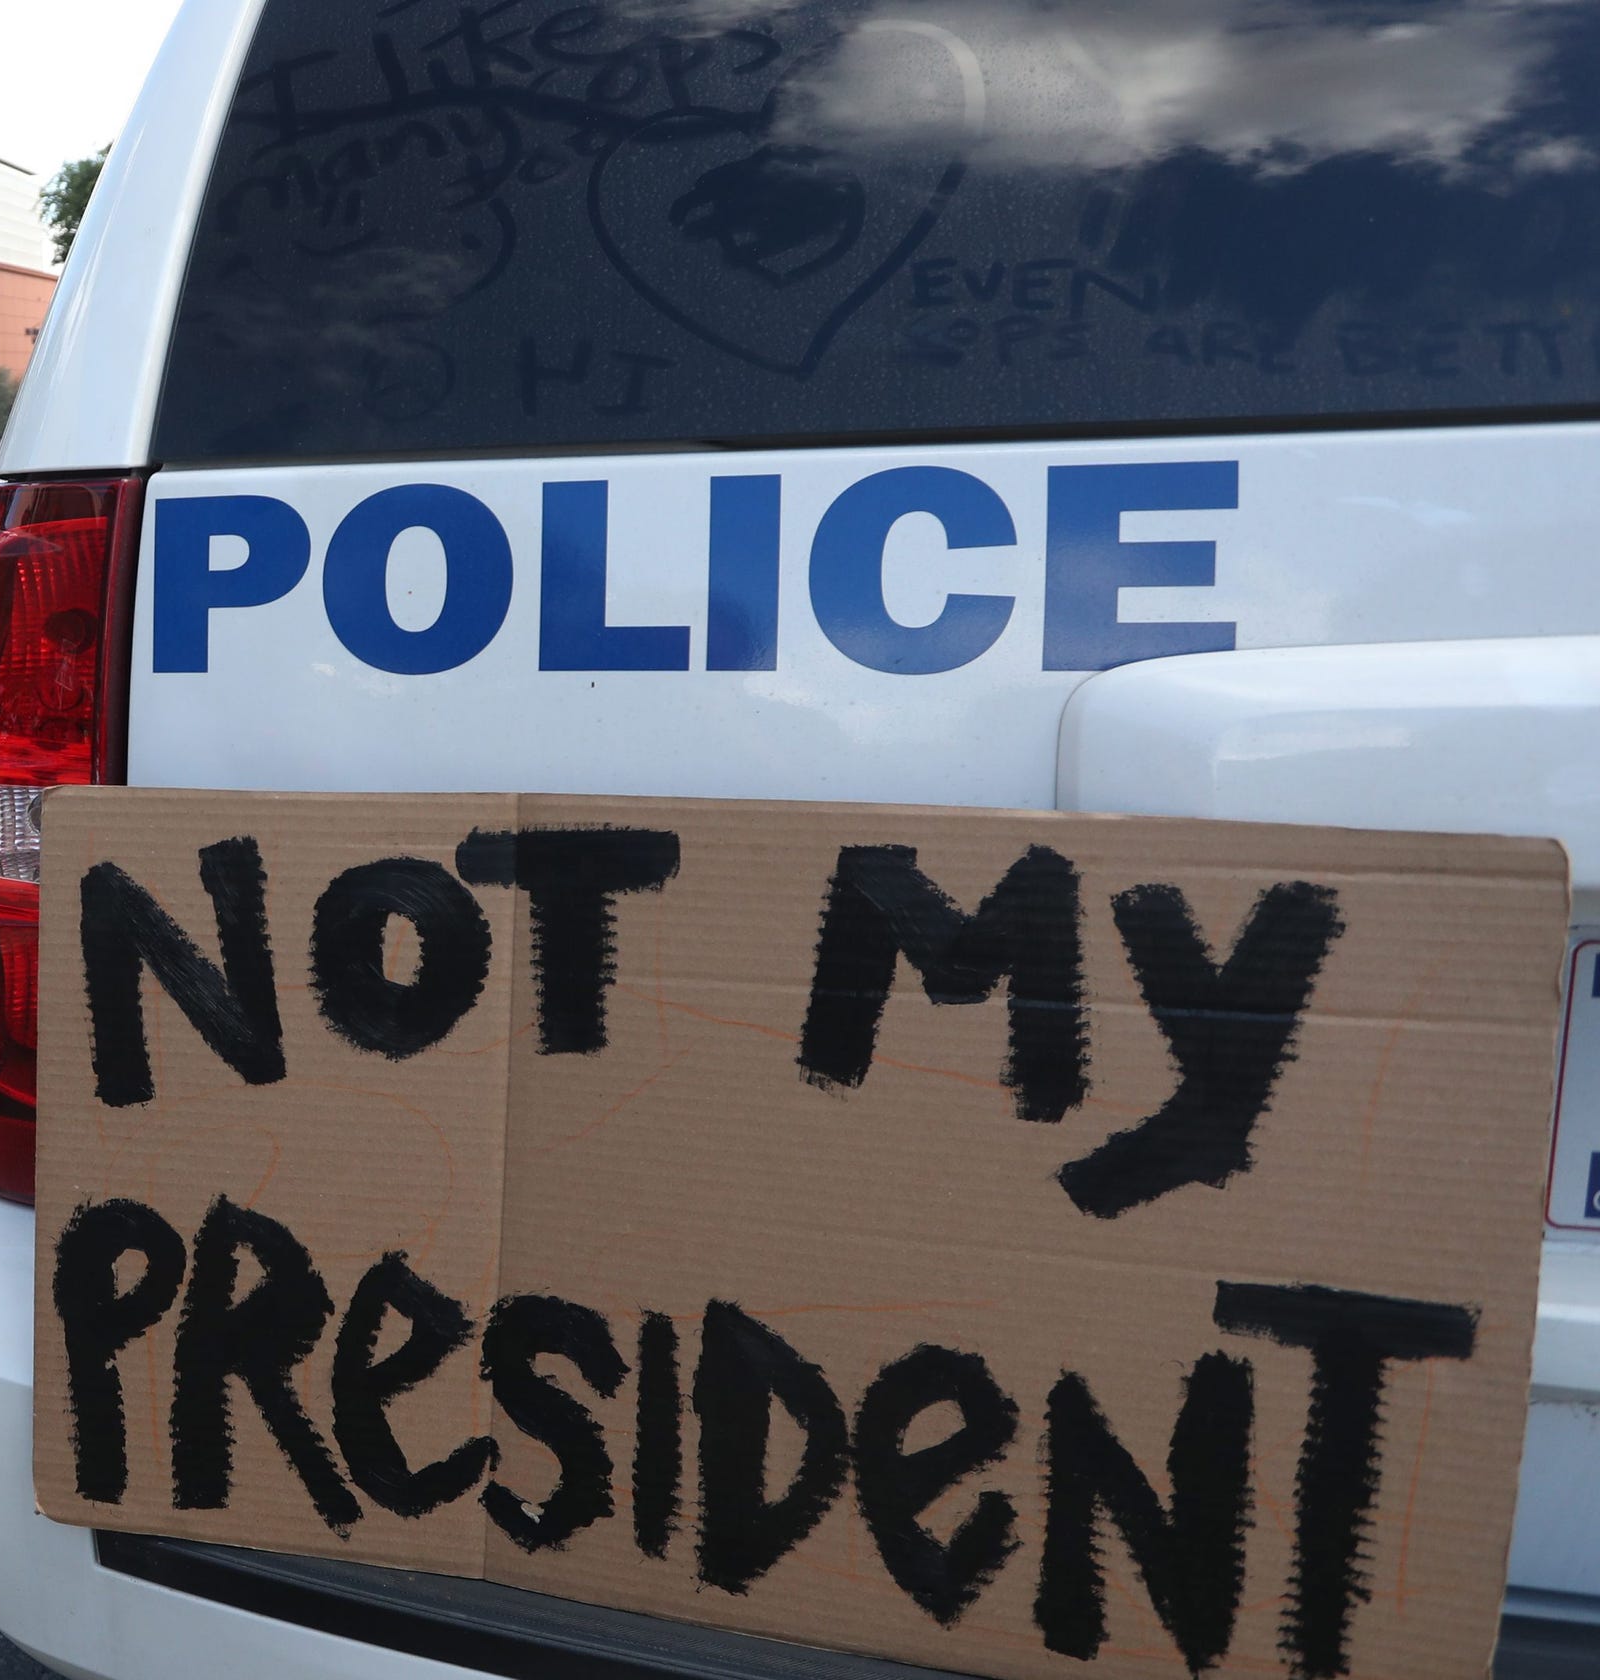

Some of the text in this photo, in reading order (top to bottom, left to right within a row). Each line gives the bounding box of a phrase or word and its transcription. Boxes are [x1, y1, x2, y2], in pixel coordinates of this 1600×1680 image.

[1338, 318, 1600, 382] BETT
[152, 460, 1239, 675] POLICE
[79, 822, 682, 1109] NOT
